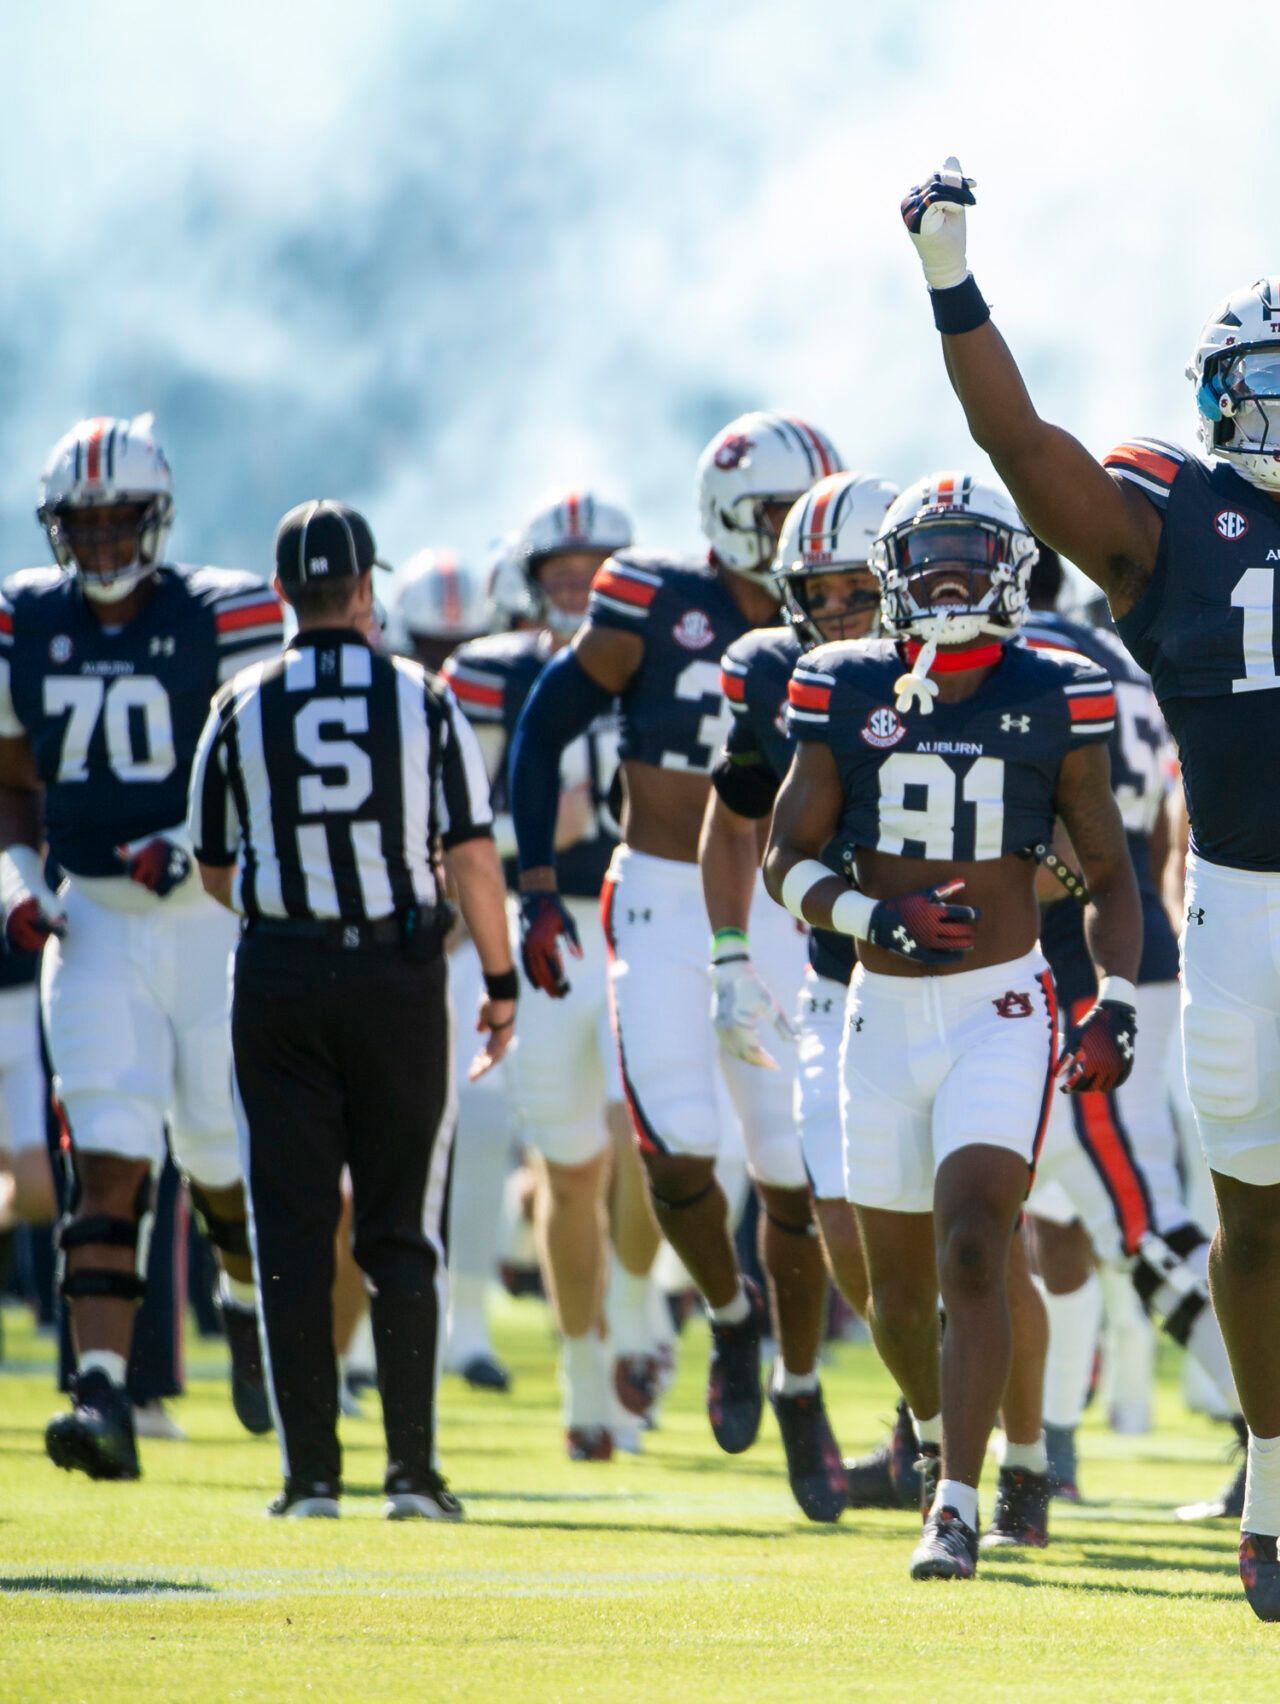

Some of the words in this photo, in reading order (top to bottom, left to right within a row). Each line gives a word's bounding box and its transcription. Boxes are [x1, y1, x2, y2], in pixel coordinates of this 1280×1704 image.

[1217, 511, 1246, 539] SEC
[42, 674, 178, 783] 70
[870, 708, 898, 738] SEC
[292, 695, 373, 814] S
[916, 741, 984, 755] AUBURN
